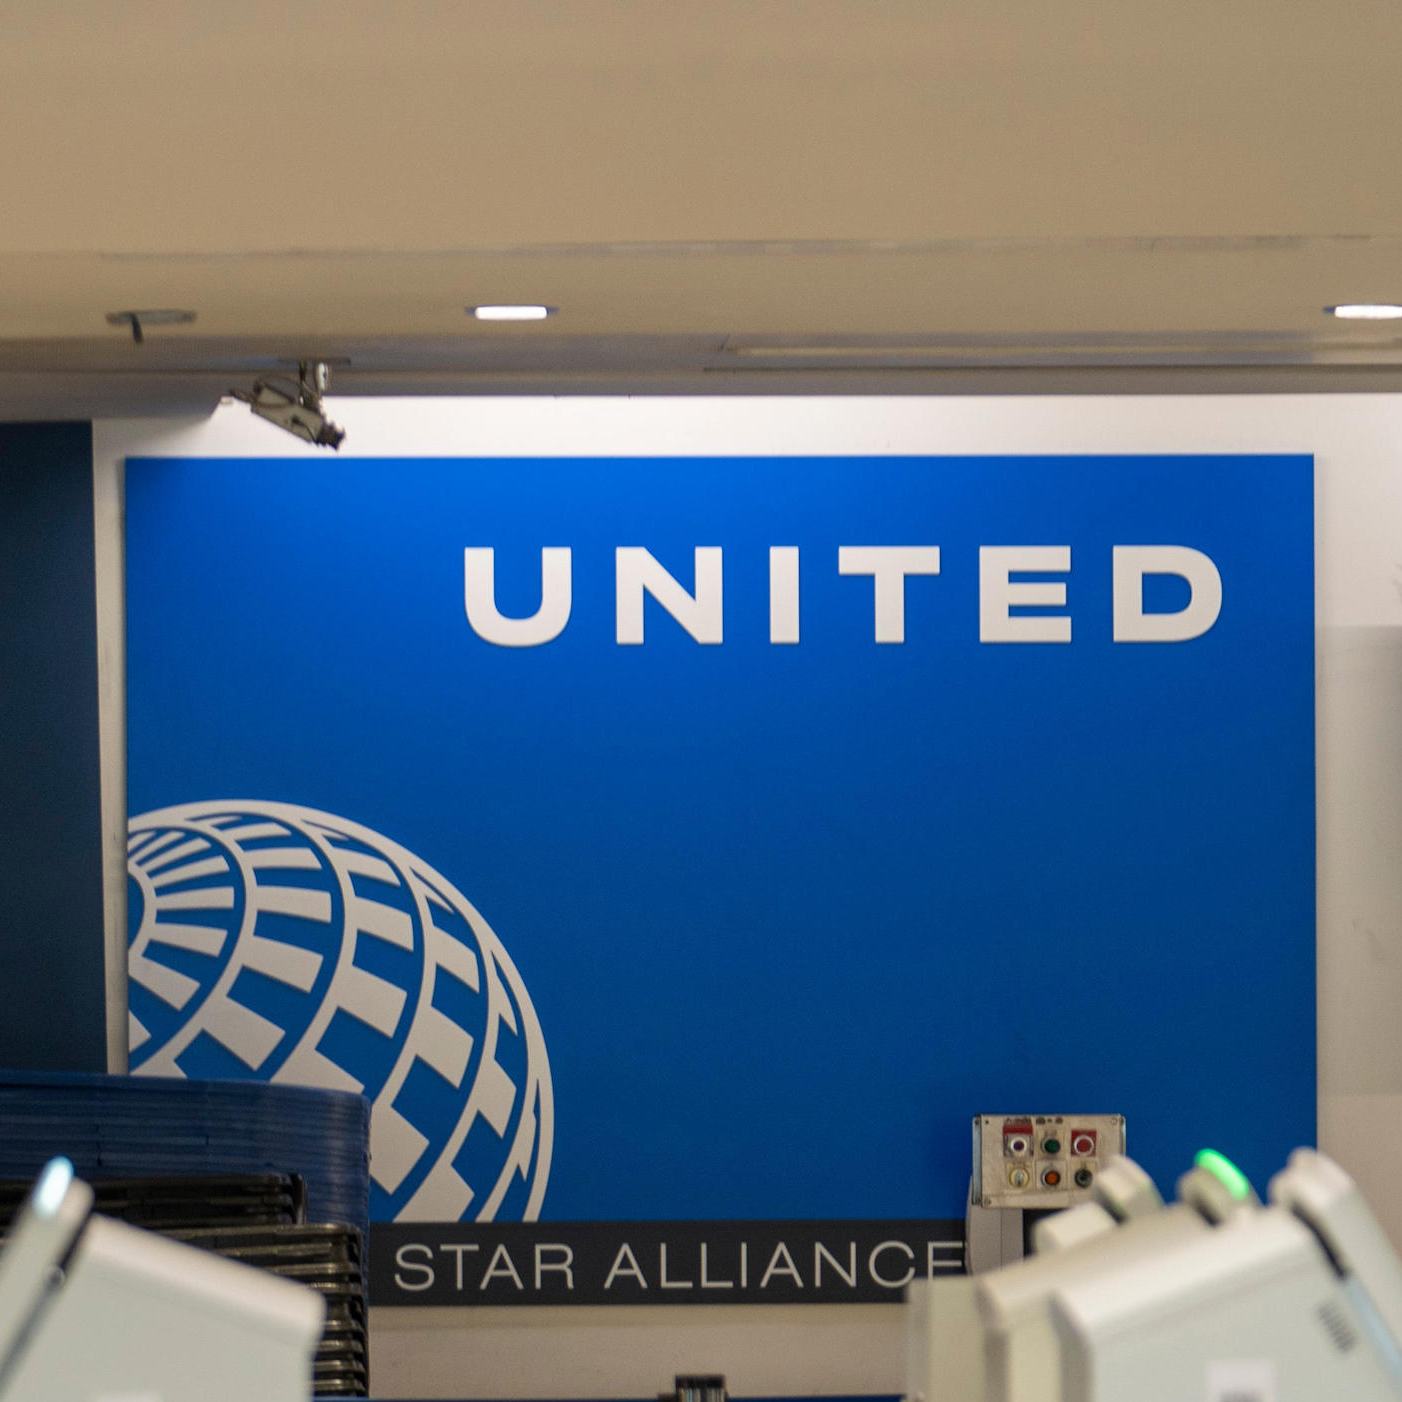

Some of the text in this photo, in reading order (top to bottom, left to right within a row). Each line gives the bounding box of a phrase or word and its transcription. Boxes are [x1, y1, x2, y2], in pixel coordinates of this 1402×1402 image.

[463, 544, 1224, 648] UNITED
[393, 1240, 966, 1290] STAR ALLIANCE
